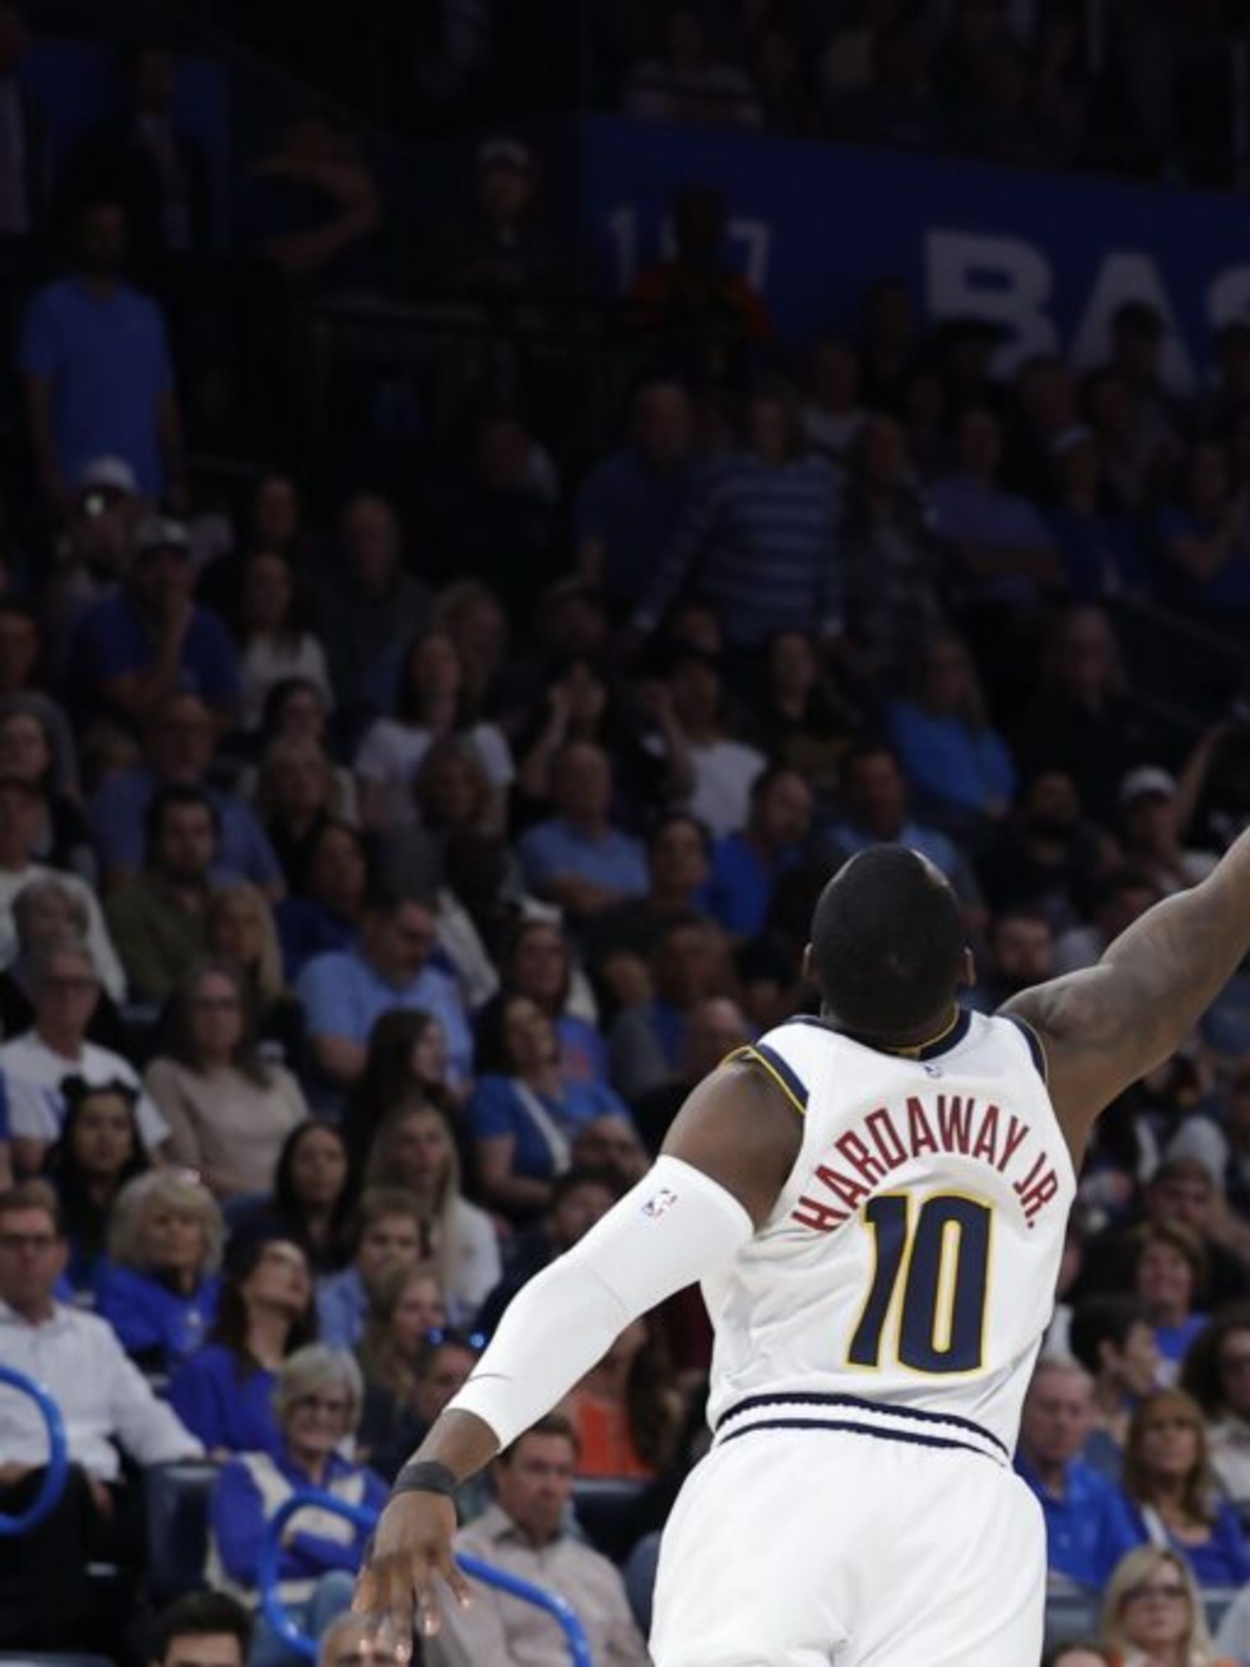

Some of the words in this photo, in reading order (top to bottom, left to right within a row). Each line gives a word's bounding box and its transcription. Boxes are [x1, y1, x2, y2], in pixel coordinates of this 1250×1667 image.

[605, 202, 772, 300] 17
[791, 1094, 1029, 1232] HARDAWAY
[1012, 1151, 1060, 1231] JR.
[845, 1190, 994, 1377] 10
